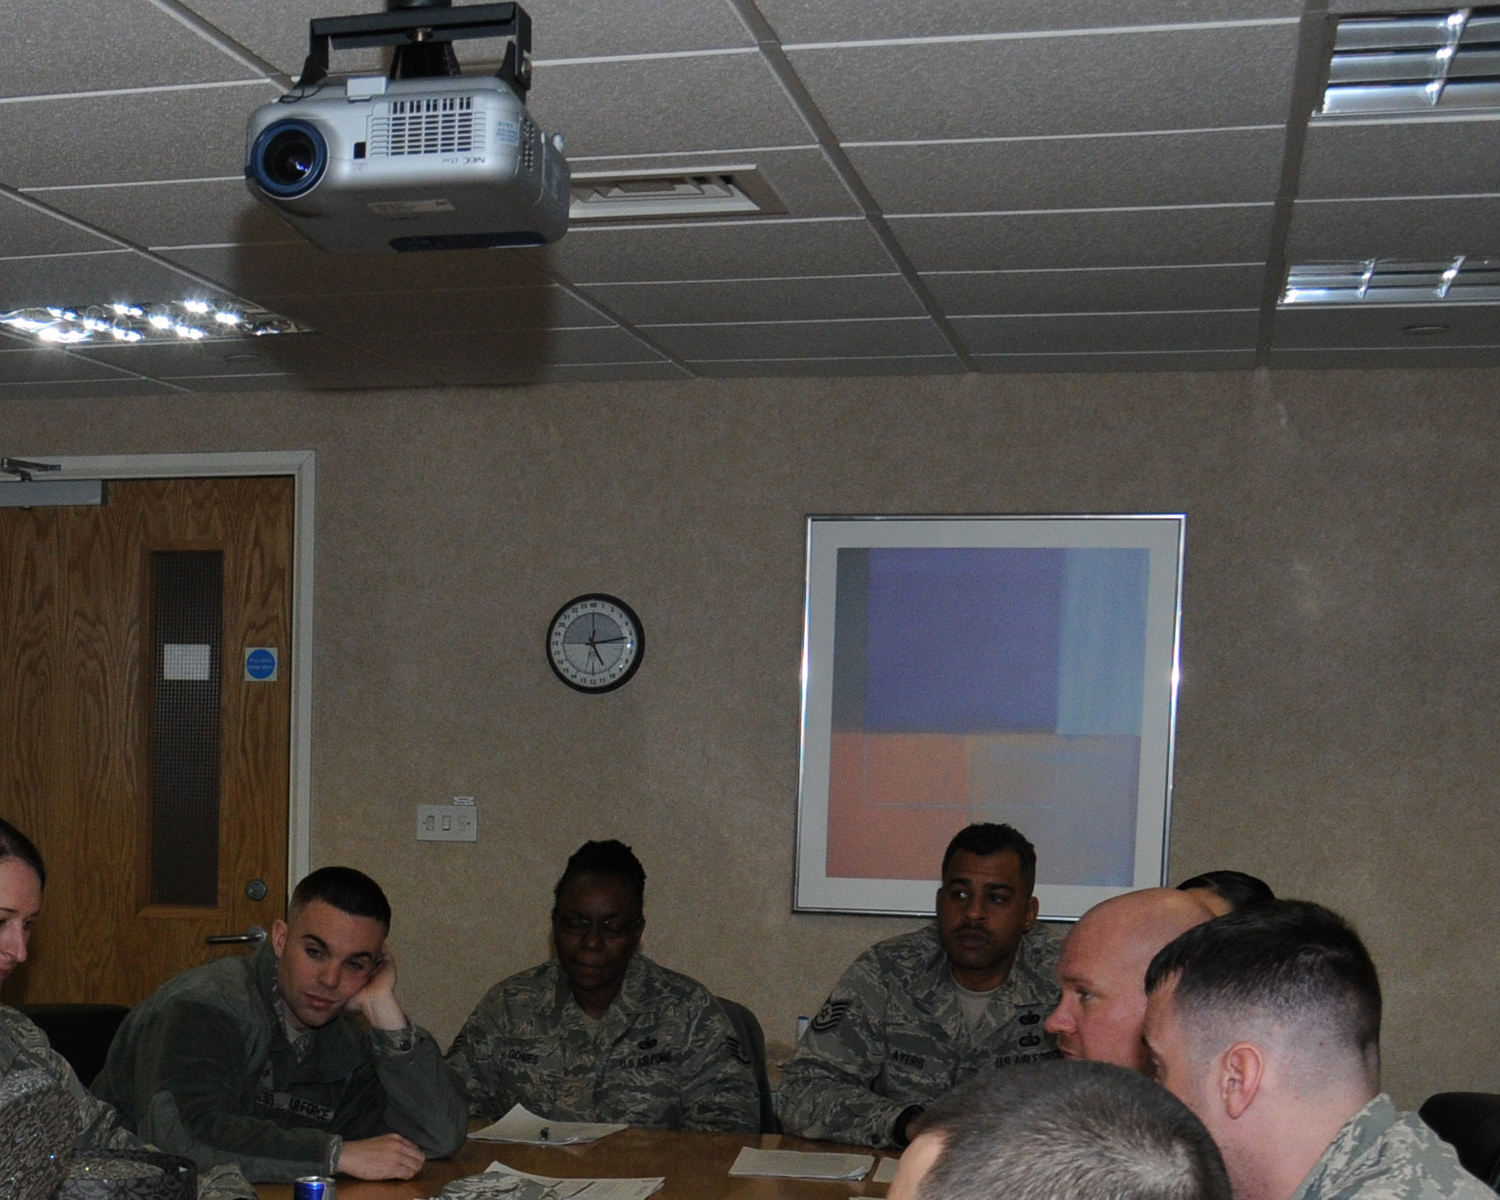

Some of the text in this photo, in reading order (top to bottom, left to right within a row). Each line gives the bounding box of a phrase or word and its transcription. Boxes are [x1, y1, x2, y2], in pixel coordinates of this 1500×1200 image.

[465, 157, 486, 165] NEC
[891, 1050, 925, 1070] AYERS
[1014, 1054, 1031, 1065] AIR
